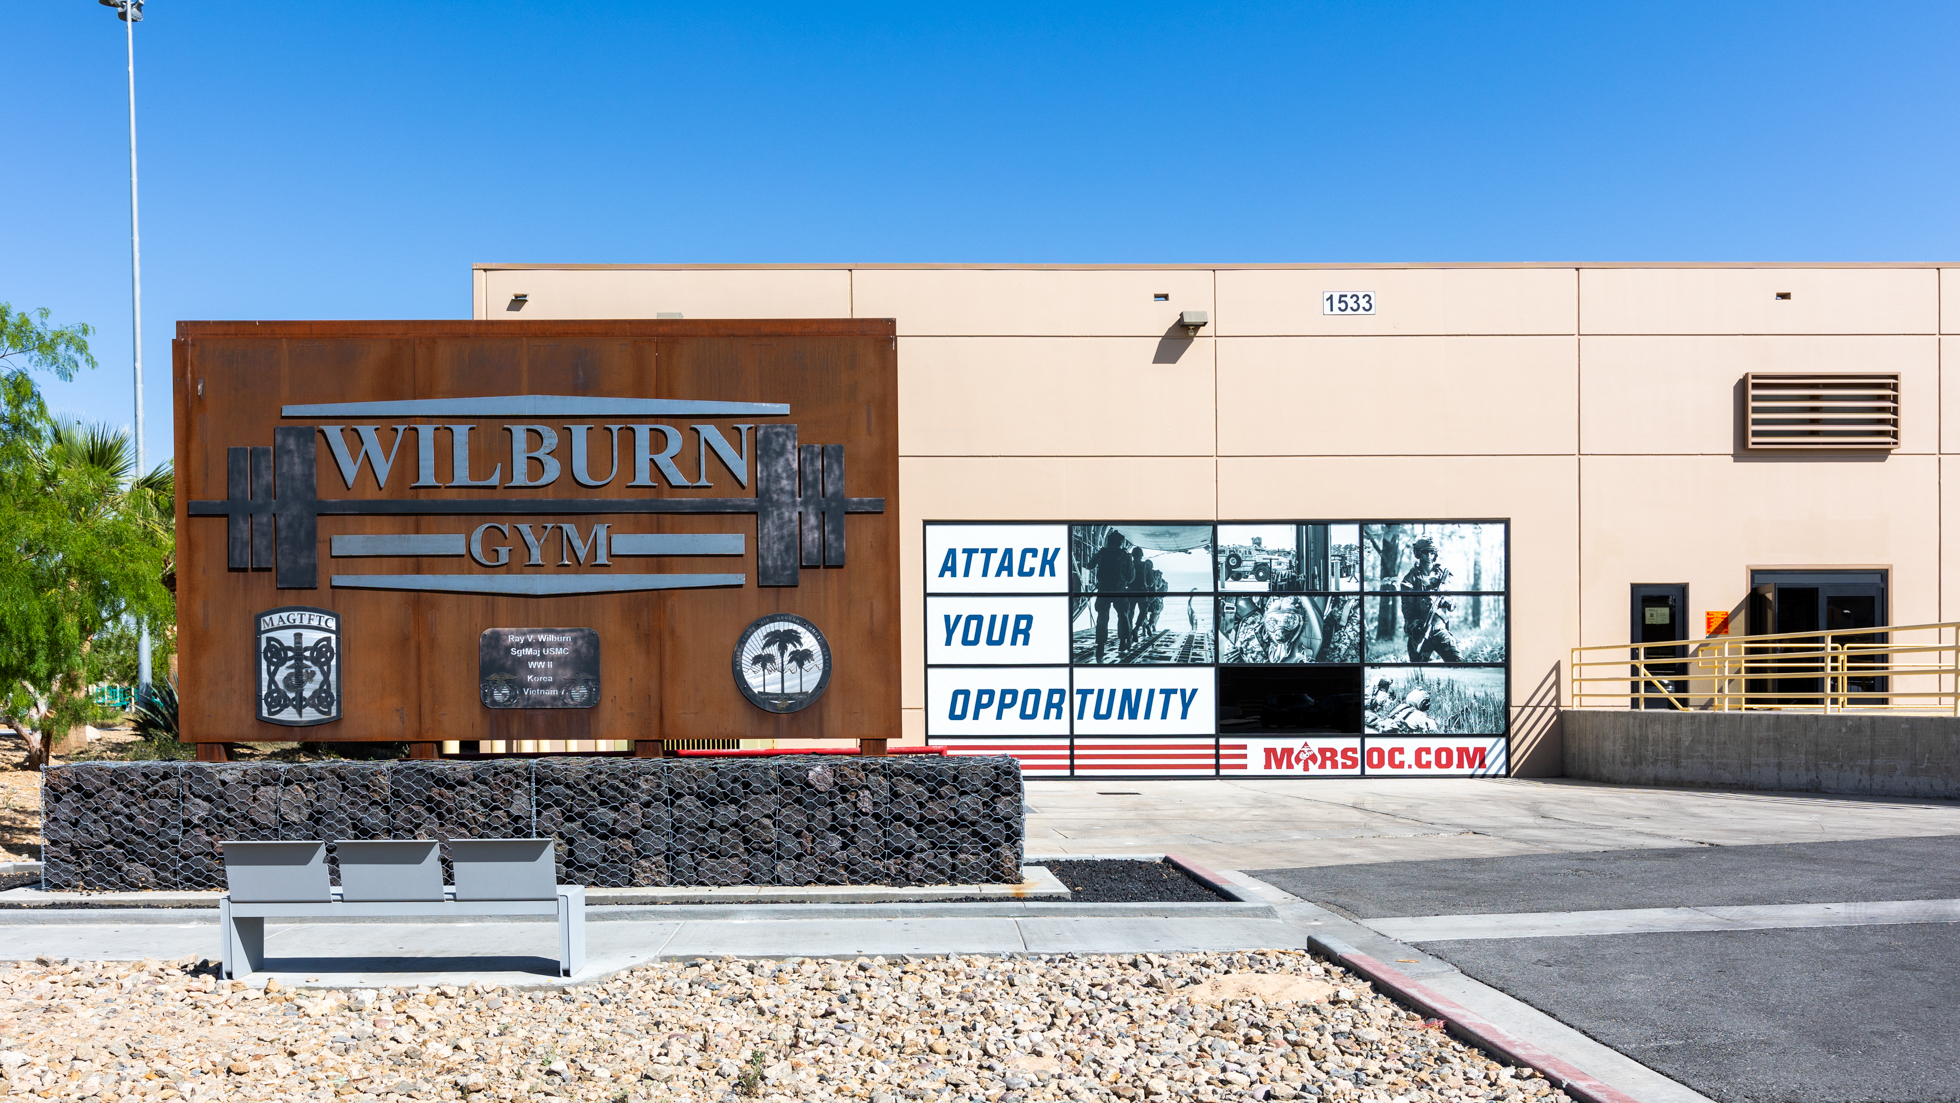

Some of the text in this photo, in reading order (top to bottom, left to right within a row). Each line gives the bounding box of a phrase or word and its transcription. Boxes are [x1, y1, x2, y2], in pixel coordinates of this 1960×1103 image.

[1326, 294, 1373, 312] 1533
[318, 424, 755, 490] WILBURN
[469, 522, 613, 566] GYM
[938, 548, 1061, 578] ATTACK
[262, 612, 335, 629] MAGTFTC
[944, 614, 1034, 646] YOUR
[508, 634, 572, 644] Ray V. Wilburn
[510, 647, 569, 657] SgtMaj USMC
[948, 688, 1199, 720] OPPORTUNITY
